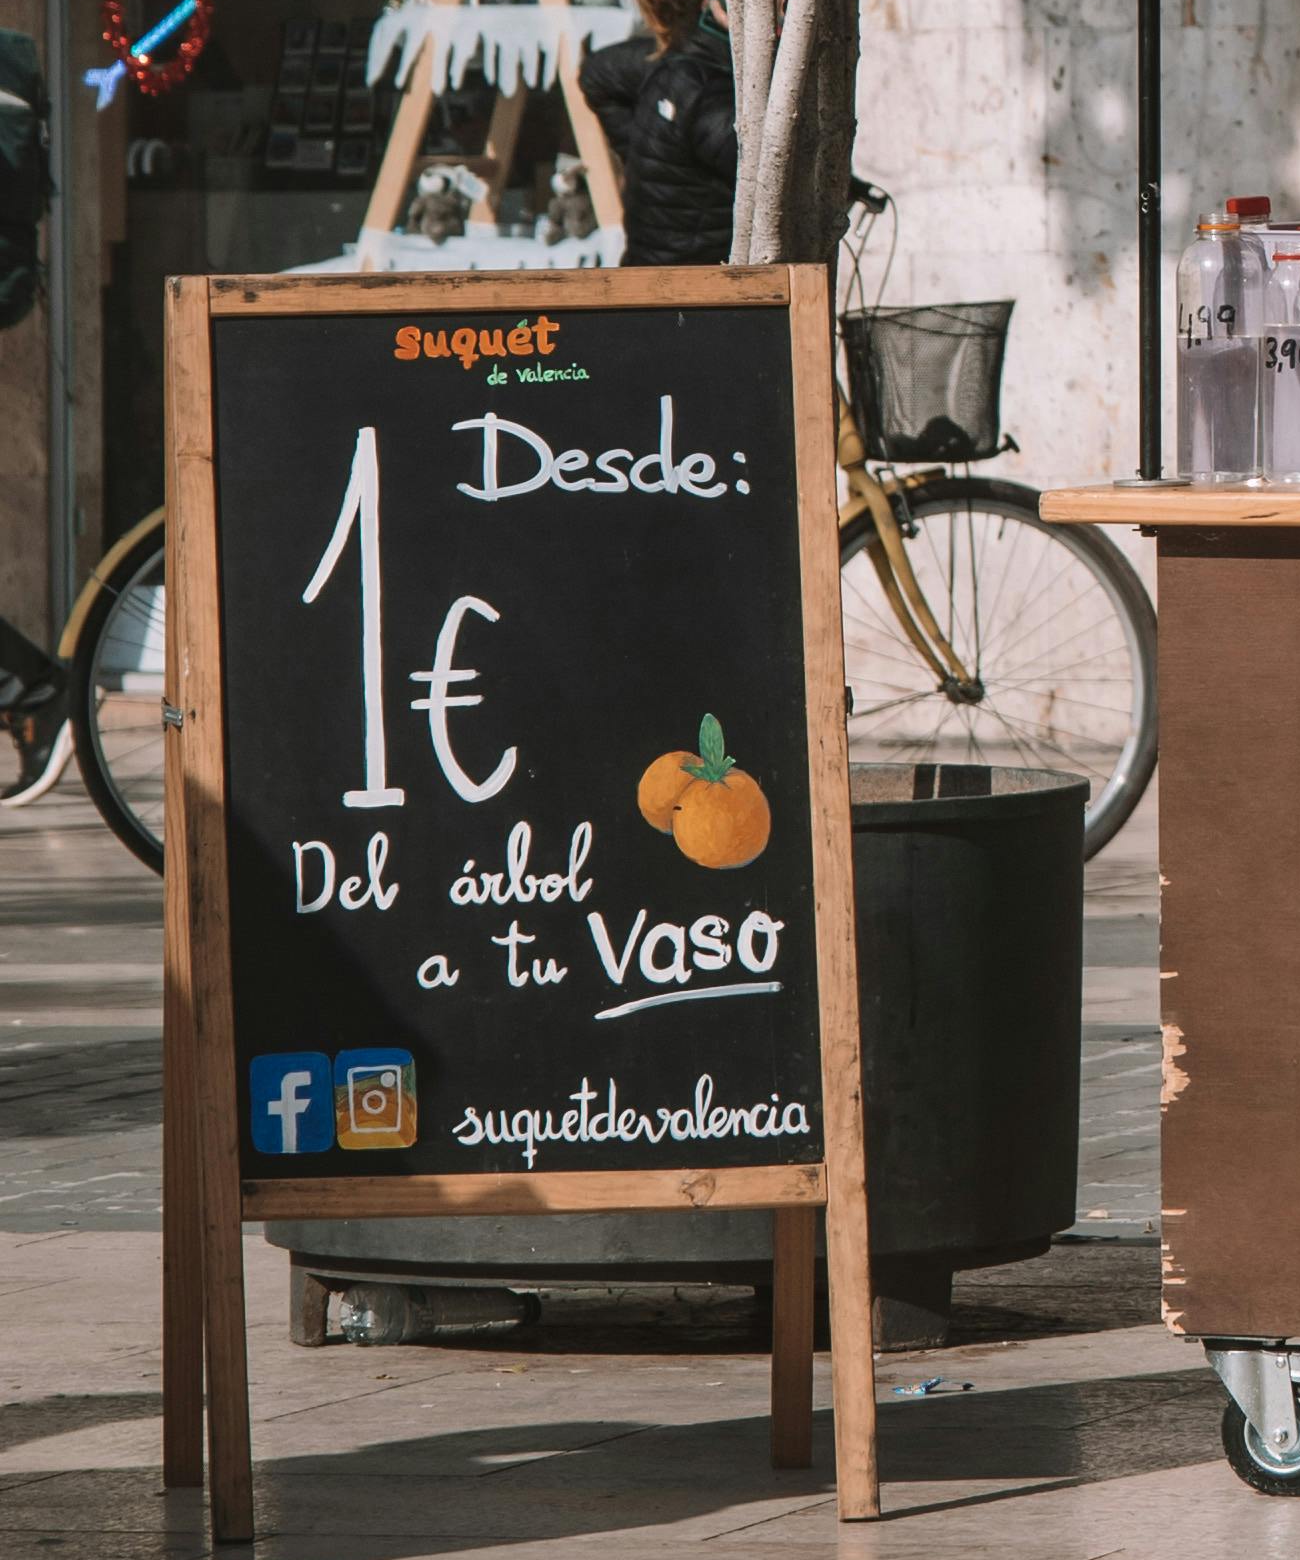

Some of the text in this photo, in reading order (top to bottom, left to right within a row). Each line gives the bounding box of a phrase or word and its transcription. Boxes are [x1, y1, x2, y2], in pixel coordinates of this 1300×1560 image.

[486, 363, 508, 386] de
[451, 394, 751, 501] Desde:
[292, 821, 594, 914] Del árbol
[416, 953, 460, 990] a
[491, 920, 568, 989] tu
[452, 1073, 811, 1170] suquetdevalencia
